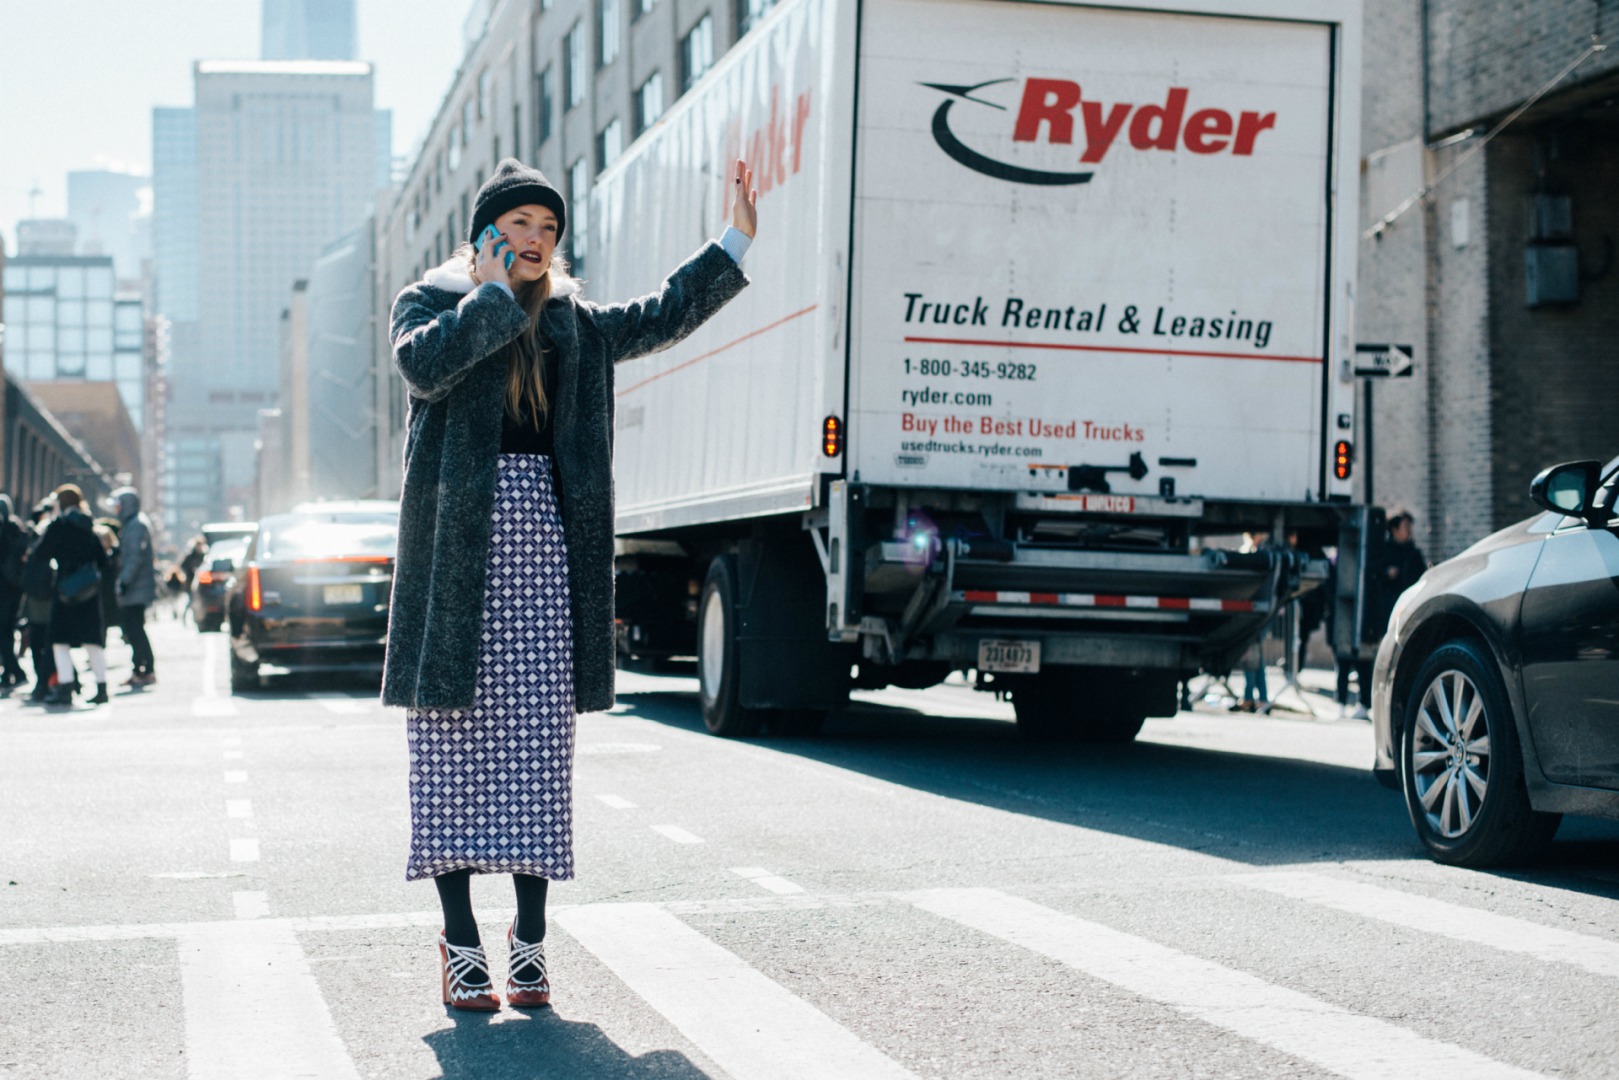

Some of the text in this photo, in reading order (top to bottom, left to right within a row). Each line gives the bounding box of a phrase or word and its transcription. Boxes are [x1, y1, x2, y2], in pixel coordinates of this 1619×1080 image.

[1013, 77, 1276, 163] Ryder
[904, 293, 1272, 348] Truck Rental & Leasing
[904, 358, 1037, 381] 1-800-345-9282
[902, 386, 992, 407] ryder.com
[902, 413, 1145, 442] Buy the Best Used Trucks
[901, 440, 1042, 457] usedtrucks.ryder.com
